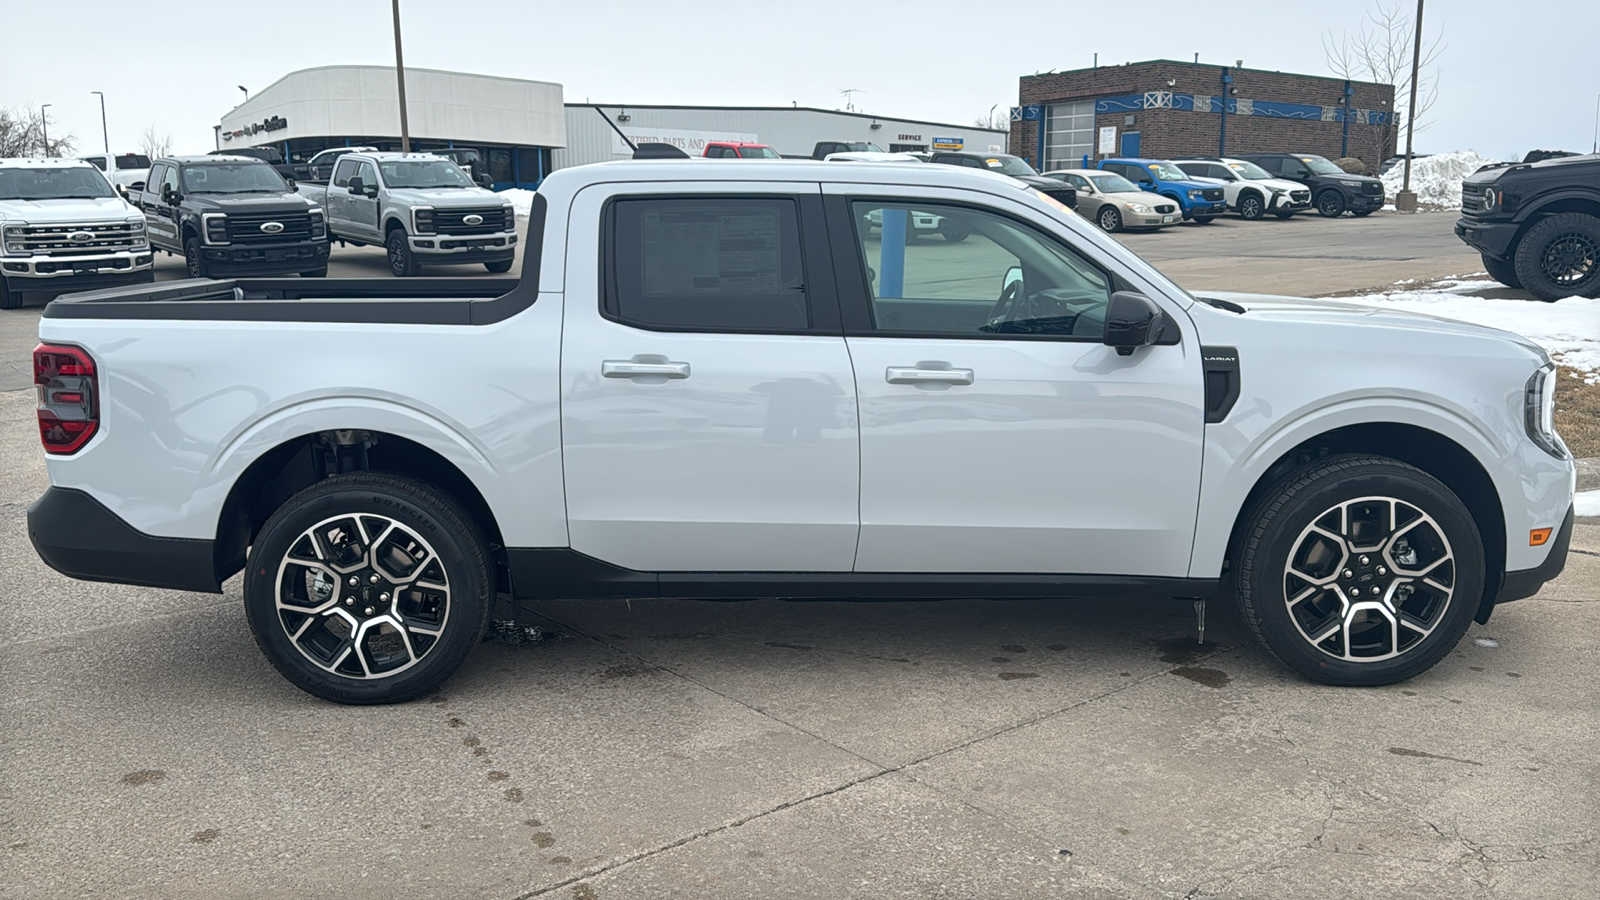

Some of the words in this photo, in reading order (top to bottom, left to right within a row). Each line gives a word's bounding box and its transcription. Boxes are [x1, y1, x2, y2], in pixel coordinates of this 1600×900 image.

[663, 137, 686, 149] PARTS
[688, 139, 705, 150] AND
[373, 496, 437, 533] WRANGLER
